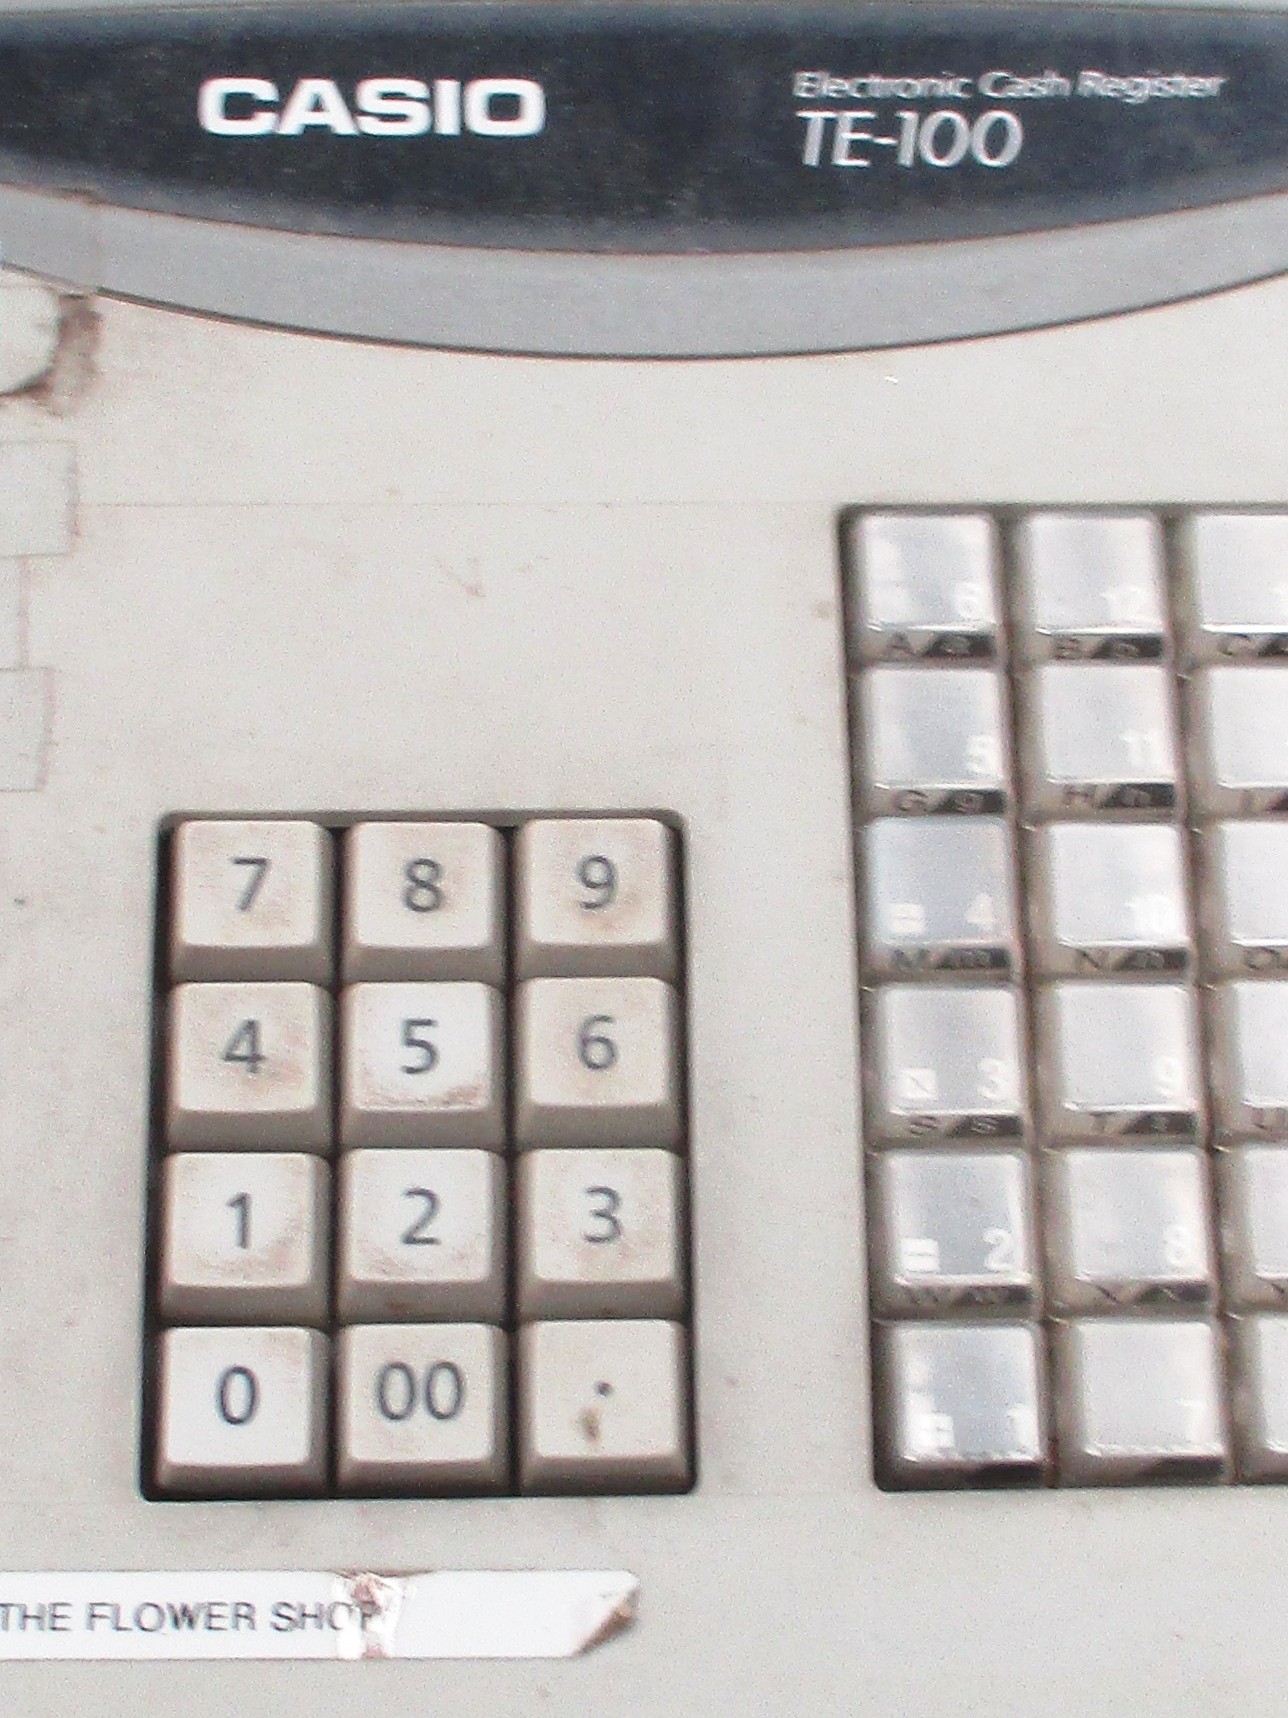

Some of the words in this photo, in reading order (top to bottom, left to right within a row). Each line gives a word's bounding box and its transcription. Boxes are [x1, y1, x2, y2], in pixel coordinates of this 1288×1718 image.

[196, 76, 548, 138] CASIO
[792, 70, 973, 99] Electronic
[977, 69, 1071, 99] Cash
[1075, 69, 1227, 104] Register
[795, 109, 1024, 168] TE-100
[230, 856, 269, 912] 7
[403, 857, 444, 913] 8
[575, 853, 619, 910] 9
[221, 1018, 266, 1074] 4
[399, 1018, 441, 1075] 5
[577, 1013, 619, 1071] 6
[976, 1058, 1012, 1100] 3
[225, 1191, 252, 1250] 1
[399, 1187, 441, 1246] 2
[582, 1185, 624, 1244] 3
[982, 1226, 1016, 1271] 2
[216, 1365, 260, 1425] 0
[374, 1360, 466, 1422] 00
[85, 1600, 257, 1633] FLOWER
